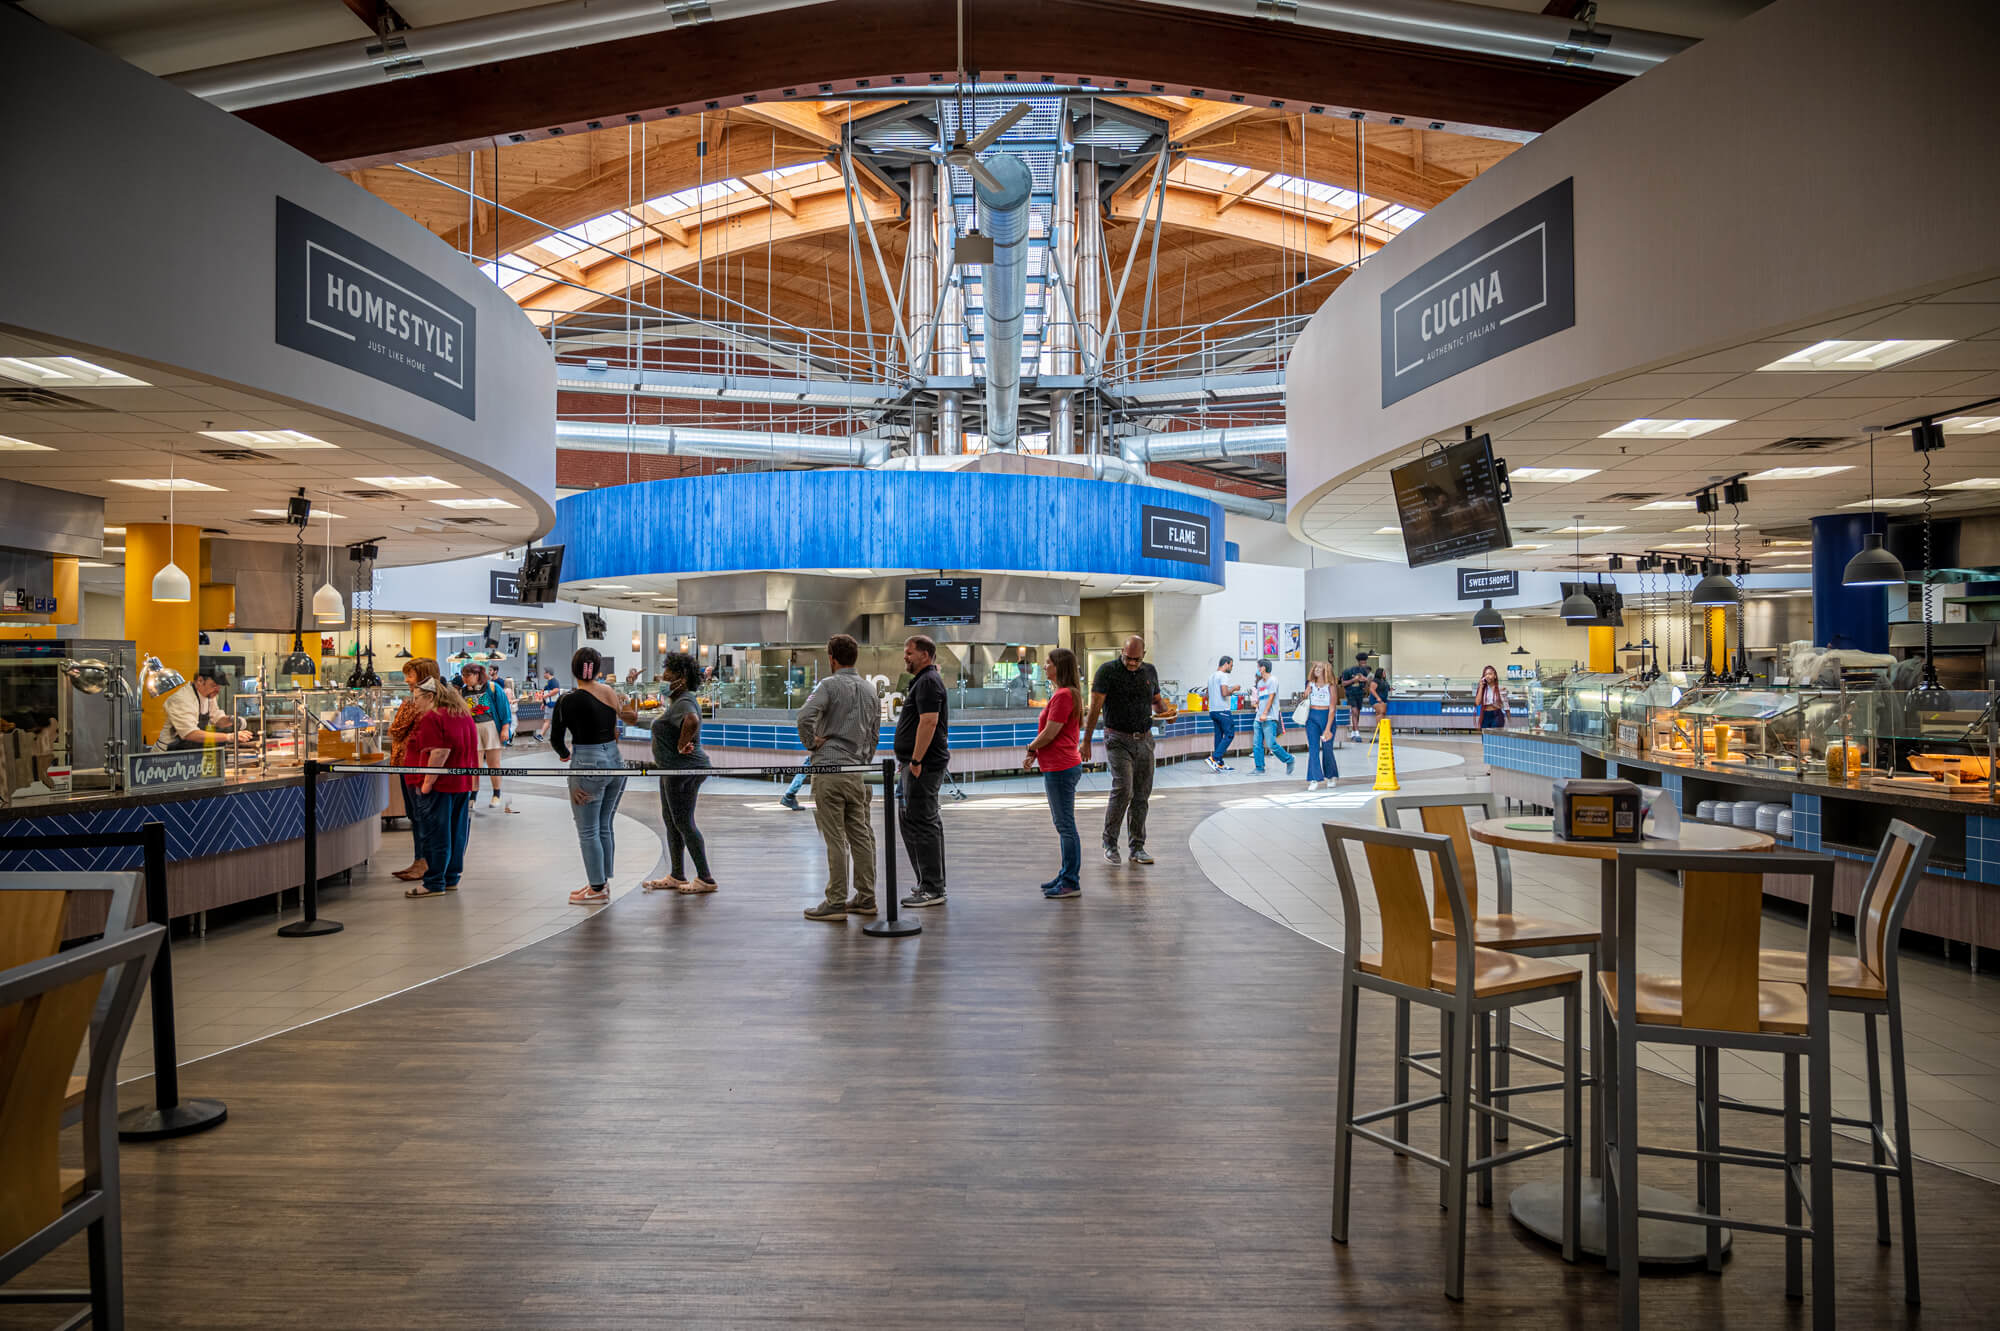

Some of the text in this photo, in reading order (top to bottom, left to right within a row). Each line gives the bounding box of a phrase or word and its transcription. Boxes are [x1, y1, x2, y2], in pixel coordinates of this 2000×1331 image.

[1421, 270, 1504, 342] CUCINA
[327, 272, 454, 363] HOMESTYLE
[1427, 321, 1496, 361] AUTHENTIC ITALIAN
[368, 340, 426, 373] JUST LIKE HOME
[1169, 527, 1196, 545] FLAME
[1469, 575, 1510, 588] SWEET SHOPPE
[18, 591, 25, 604] 2
[448, 767, 528, 776] KEEP YOUR DISTANCE
[782, 766, 802, 774] YOUR
[803, 765, 842, 774] DISTANCE
